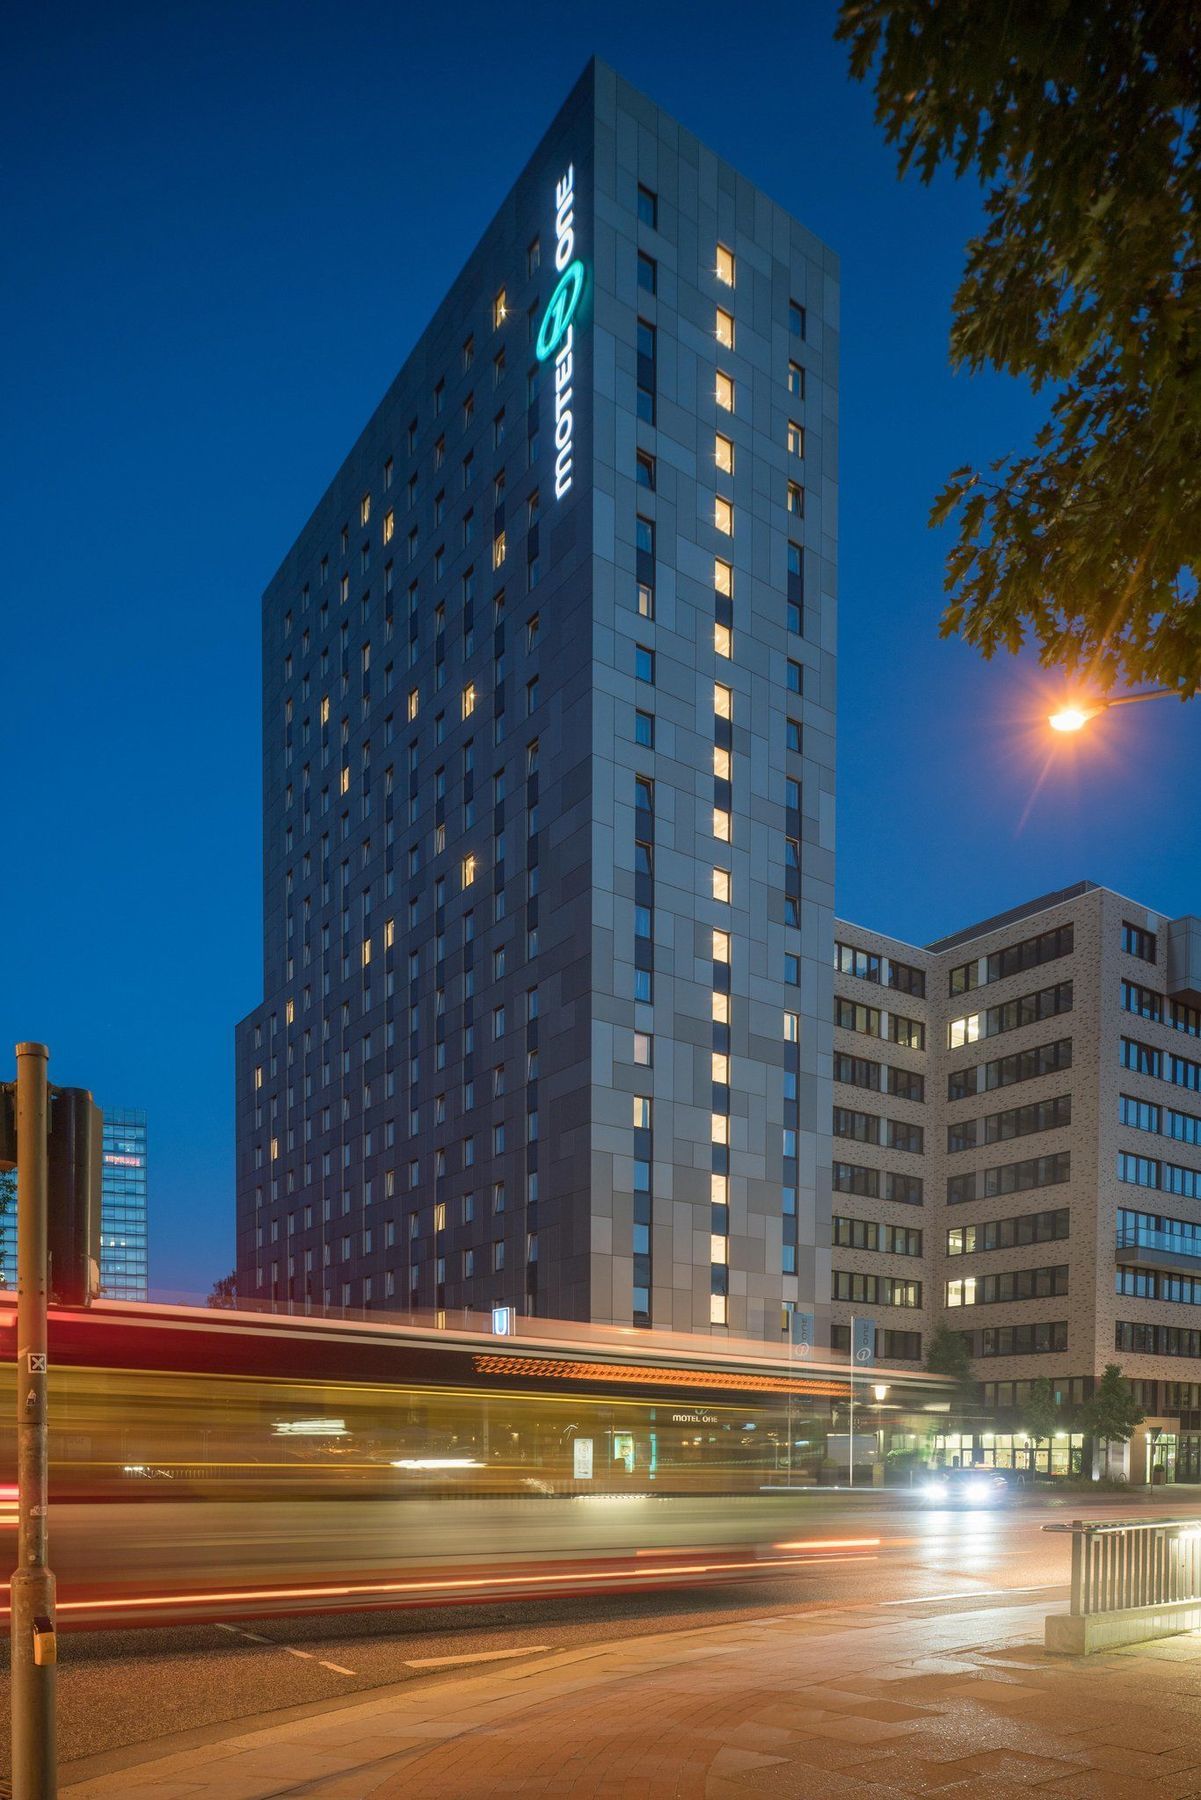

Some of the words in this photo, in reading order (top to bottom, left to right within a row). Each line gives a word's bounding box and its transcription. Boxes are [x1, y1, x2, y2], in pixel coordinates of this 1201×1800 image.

[553, 162, 574, 273] ONE
[553, 322, 573, 501] MOTEL
[494, 1310, 507, 1336] U
[672, 1414, 701, 1422] MOTEL
[702, 1415, 718, 1423] ONE
